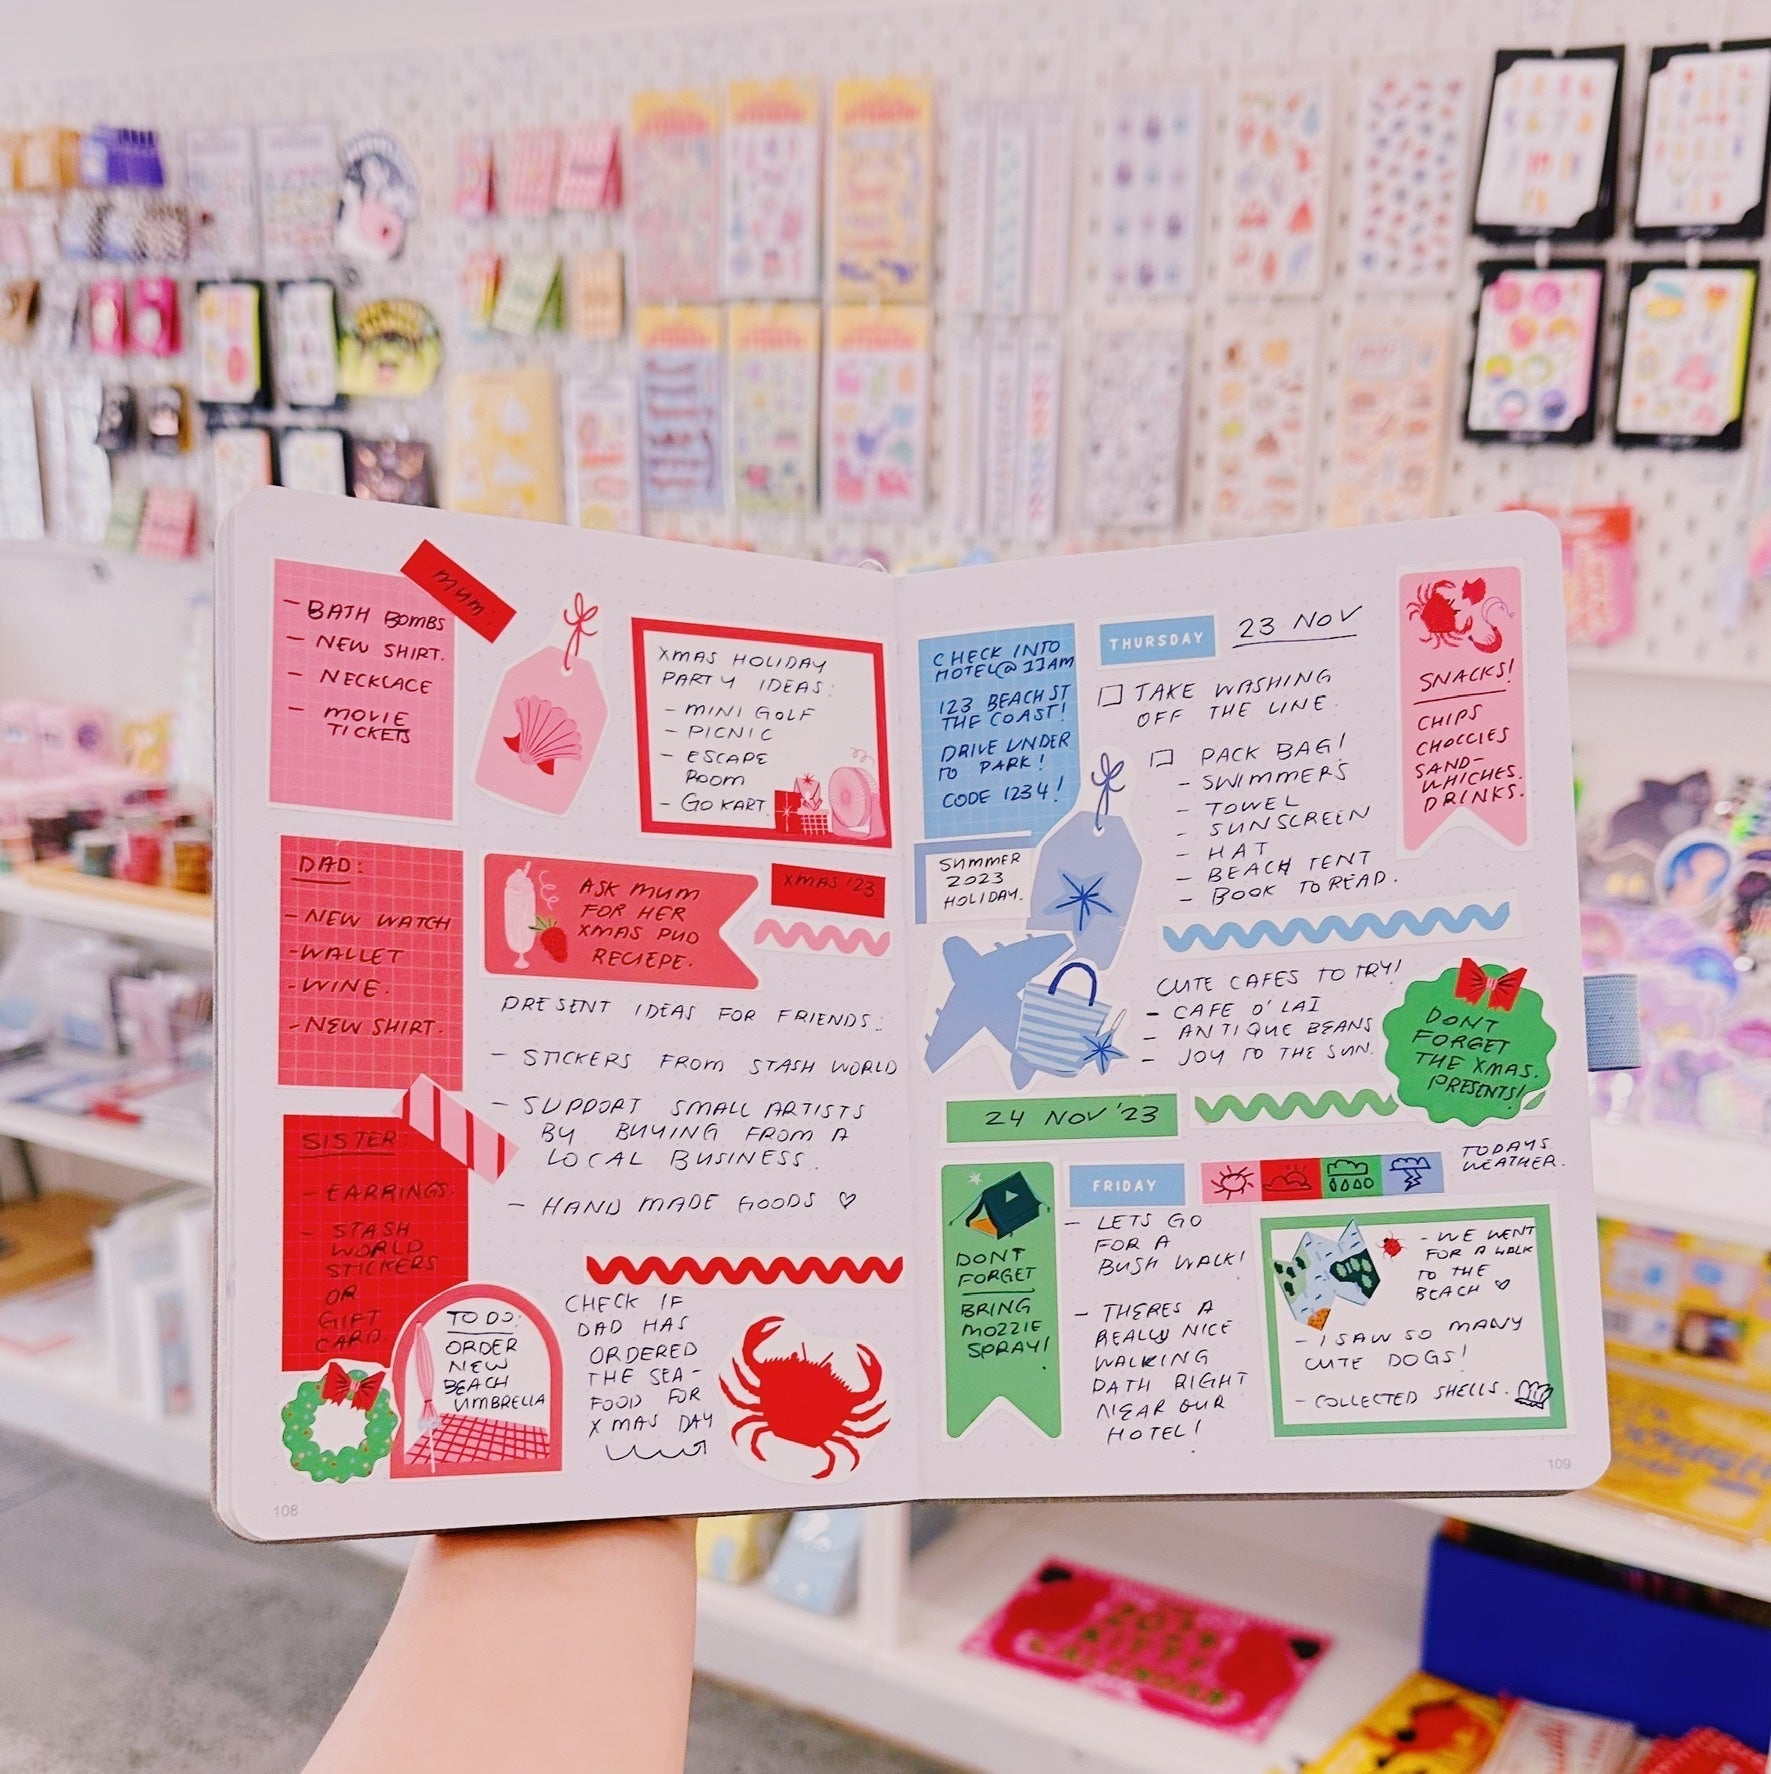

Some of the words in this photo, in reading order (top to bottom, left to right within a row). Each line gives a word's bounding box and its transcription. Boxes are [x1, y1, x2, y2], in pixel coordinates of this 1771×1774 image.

[308, 600, 370, 623] BATH
[385, 611, 445, 631] BOMBS
[1239, 618, 1275, 638] 23
[1293, 605, 1362, 630] NOV
[316, 635, 368, 653] NEW
[384, 644, 445, 661] SHIRT.
[1110, 633, 1204, 650] THURSDAY
[659, 646, 717, 664] XMAS
[733, 654, 826, 673] HOLIDAY
[934, 646, 1001, 667] CHECK
[1014, 640, 1060, 658] INTO
[321, 670, 432, 694] NECKLACE
[662, 672, 736, 689] PARTY
[1136, 683, 1196, 701] TAKE
[1216, 669, 1331, 698] WASHING
[1420, 658, 1514, 692] SNACKS!
[939, 698, 972, 714] 123
[988, 687, 1042, 712] BEACH
[1052, 685, 1071, 701] ST
[325, 706, 409, 726] MOVIE
[686, 704, 742, 717] MINI
[756, 706, 815, 720] GOLF
[942, 714, 981, 731] THE
[990, 704, 1066, 726] COAST!
[1137, 709, 1183, 728] OFF
[1210, 702, 1251, 720] THE
[1418, 704, 1482, 731] CHIPS
[328, 723, 410, 743] TICKETS
[689, 726, 773, 740] PICNIC
[1416, 727, 1509, 756] CHOCCIES
[688, 750, 768, 764] ESCAPE
[941, 740, 998, 762] DRIVE
[1007, 732, 1071, 752] UNDER
[1201, 746, 1259, 766] PACK
[686, 770, 744, 786] ROOM
[939, 768, 957, 781] TO
[1203, 763, 1350, 791] SWIMMERS
[681, 793, 713, 812] GO
[943, 790, 991, 808] CODE
[1206, 796, 1300, 817] TOWEL
[1424, 784, 1524, 813] DRINKS.
[1210, 806, 1370, 837] SUNSCREEN
[1209, 842, 1269, 860] HAT
[299, 856, 363, 873] DAD:
[940, 853, 1021, 871] SUMMER
[1209, 858, 1291, 882] BEACH
[1309, 851, 1370, 870] TENT
[579, 878, 620, 897] ASK
[784, 874, 838, 889] XMAS
[946, 873, 1004, 887] 2023
[1212, 885, 1275, 905] BOOK
[1300, 880, 1320, 894] TO
[306, 909, 360, 927] NEW
[377, 914, 451, 930] WATCH
[581, 904, 624, 919] FOR
[638, 906, 686, 921] HER
[578, 924, 642, 941] XMAS
[301, 945, 403, 964] WALLET
[303, 979, 389, 997] WINE.
[1157, 976, 1212, 997] CUTE
[1230, 970, 1298, 990] CAFES
[1319, 966, 1347, 982] TO
[502, 996, 611, 1014] PRESENT
[635, 1004, 696, 1020] IDEAS
[719, 1008, 755, 1022] FOR
[1174, 1002, 1234, 1019] CAFE
[306, 1017, 363, 1034] NEW
[372, 1018, 443, 1035] SHIRT.
[1179, 1022, 1292, 1039] ANTIQUE
[1308, 1017, 1375, 1033] BEANS
[1426, 1006, 1500, 1033] DONT
[1412, 1030, 1510, 1054] FORGET
[524, 1050, 632, 1069] STICKERS
[660, 1055, 724, 1072] FROM
[750, 1059, 814, 1075] STASH
[832, 1059, 898, 1076] WORLD
[1179, 1048, 1224, 1067] JOY
[1243, 1047, 1269, 1062] TO
[1281, 1045, 1315, 1060] THE
[1416, 1051, 1465, 1071] THE
[1427, 1075, 1525, 1110] PRESENTS!
[525, 1098, 641, 1116] SUPPORT
[672, 1100, 750, 1117] SMALL
[765, 1104, 866, 1119] ARTISTS
[985, 1111, 1024, 1127] 24
[542, 1123, 575, 1145] BY
[616, 1123, 718, 1142] BUYING
[746, 1128, 813, 1142] FROM
[832, 1128, 848, 1142] A
[1463, 1137, 1550, 1158] TODAYS
[548, 1152, 642, 1167] LOCAL
[1093, 1179, 1156, 1192] FRIDAY
[542, 1197, 620, 1216] HAND
[639, 1194, 718, 1211] MADE
[739, 1193, 817, 1213] GOODS
[333, 1222, 410, 1238] STASH
[1098, 1214, 1150, 1230] LETS
[1168, 1213, 1202, 1228] GO
[1095, 1239, 1140, 1253] FOR
[1155, 1235, 1171, 1250] A
[1438, 1228, 1476, 1243] WE
[1487, 1225, 1536, 1240] WENT
[332, 1241, 424, 1258] WORLD
[956, 1248, 1026, 1266] DONT
[1426, 1248, 1461, 1261] FOR
[326, 1256, 438, 1278] STICKERS
[1099, 1256, 1158, 1276] BUSH
[1452, 1264, 1490, 1277] THE
[957, 1266, 1036, 1287] FORGET
[326, 1285, 358, 1306] OR
[566, 1293, 639, 1313] CHECK
[662, 1293, 684, 1308] IF
[1416, 1285, 1480, 1301] BEACH
[961, 1298, 1031, 1317] BRING
[1104, 1303, 1181, 1323] THERES
[1198, 1300, 1214, 1315] A
[319, 1310, 380, 1329] GIFT
[447, 1311, 478, 1326] TO
[578, 1320, 622, 1336] DAD
[644, 1316, 688, 1333] HAS
[1095, 1329, 1169, 1348] REALLY
[1182, 1320, 1234, 1338] NICE
[1336, 1333, 1391, 1345] SAW
[1405, 1329, 1432, 1341] SO
[1449, 1317, 1522, 1332] MANY
[446, 1341, 517, 1354] ORDER
[590, 1342, 697, 1365] ORDERED
[449, 1361, 507, 1373] NEW
[1095, 1349, 1209, 1372] WALKING
[1305, 1357, 1364, 1370] CUTE
[444, 1376, 508, 1395] BEACH
[588, 1368, 633, 1386] THE
[1093, 1378, 1150, 1395] PATH
[1175, 1372, 1248, 1389] RIGHT
[454, 1395, 545, 1411] UMBRELLA
[591, 1396, 642, 1411] FOOD
[668, 1388, 700, 1405] FOR
[1097, 1402, 1165, 1420] NEAR
[1180, 1397, 1225, 1413] OUR
[1315, 1392, 1417, 1408] COLLECTED
[680, 1413, 712, 1433] DAY
[1548, 1459, 1571, 1470] 109
[274, 1504, 298, 1518] 108
